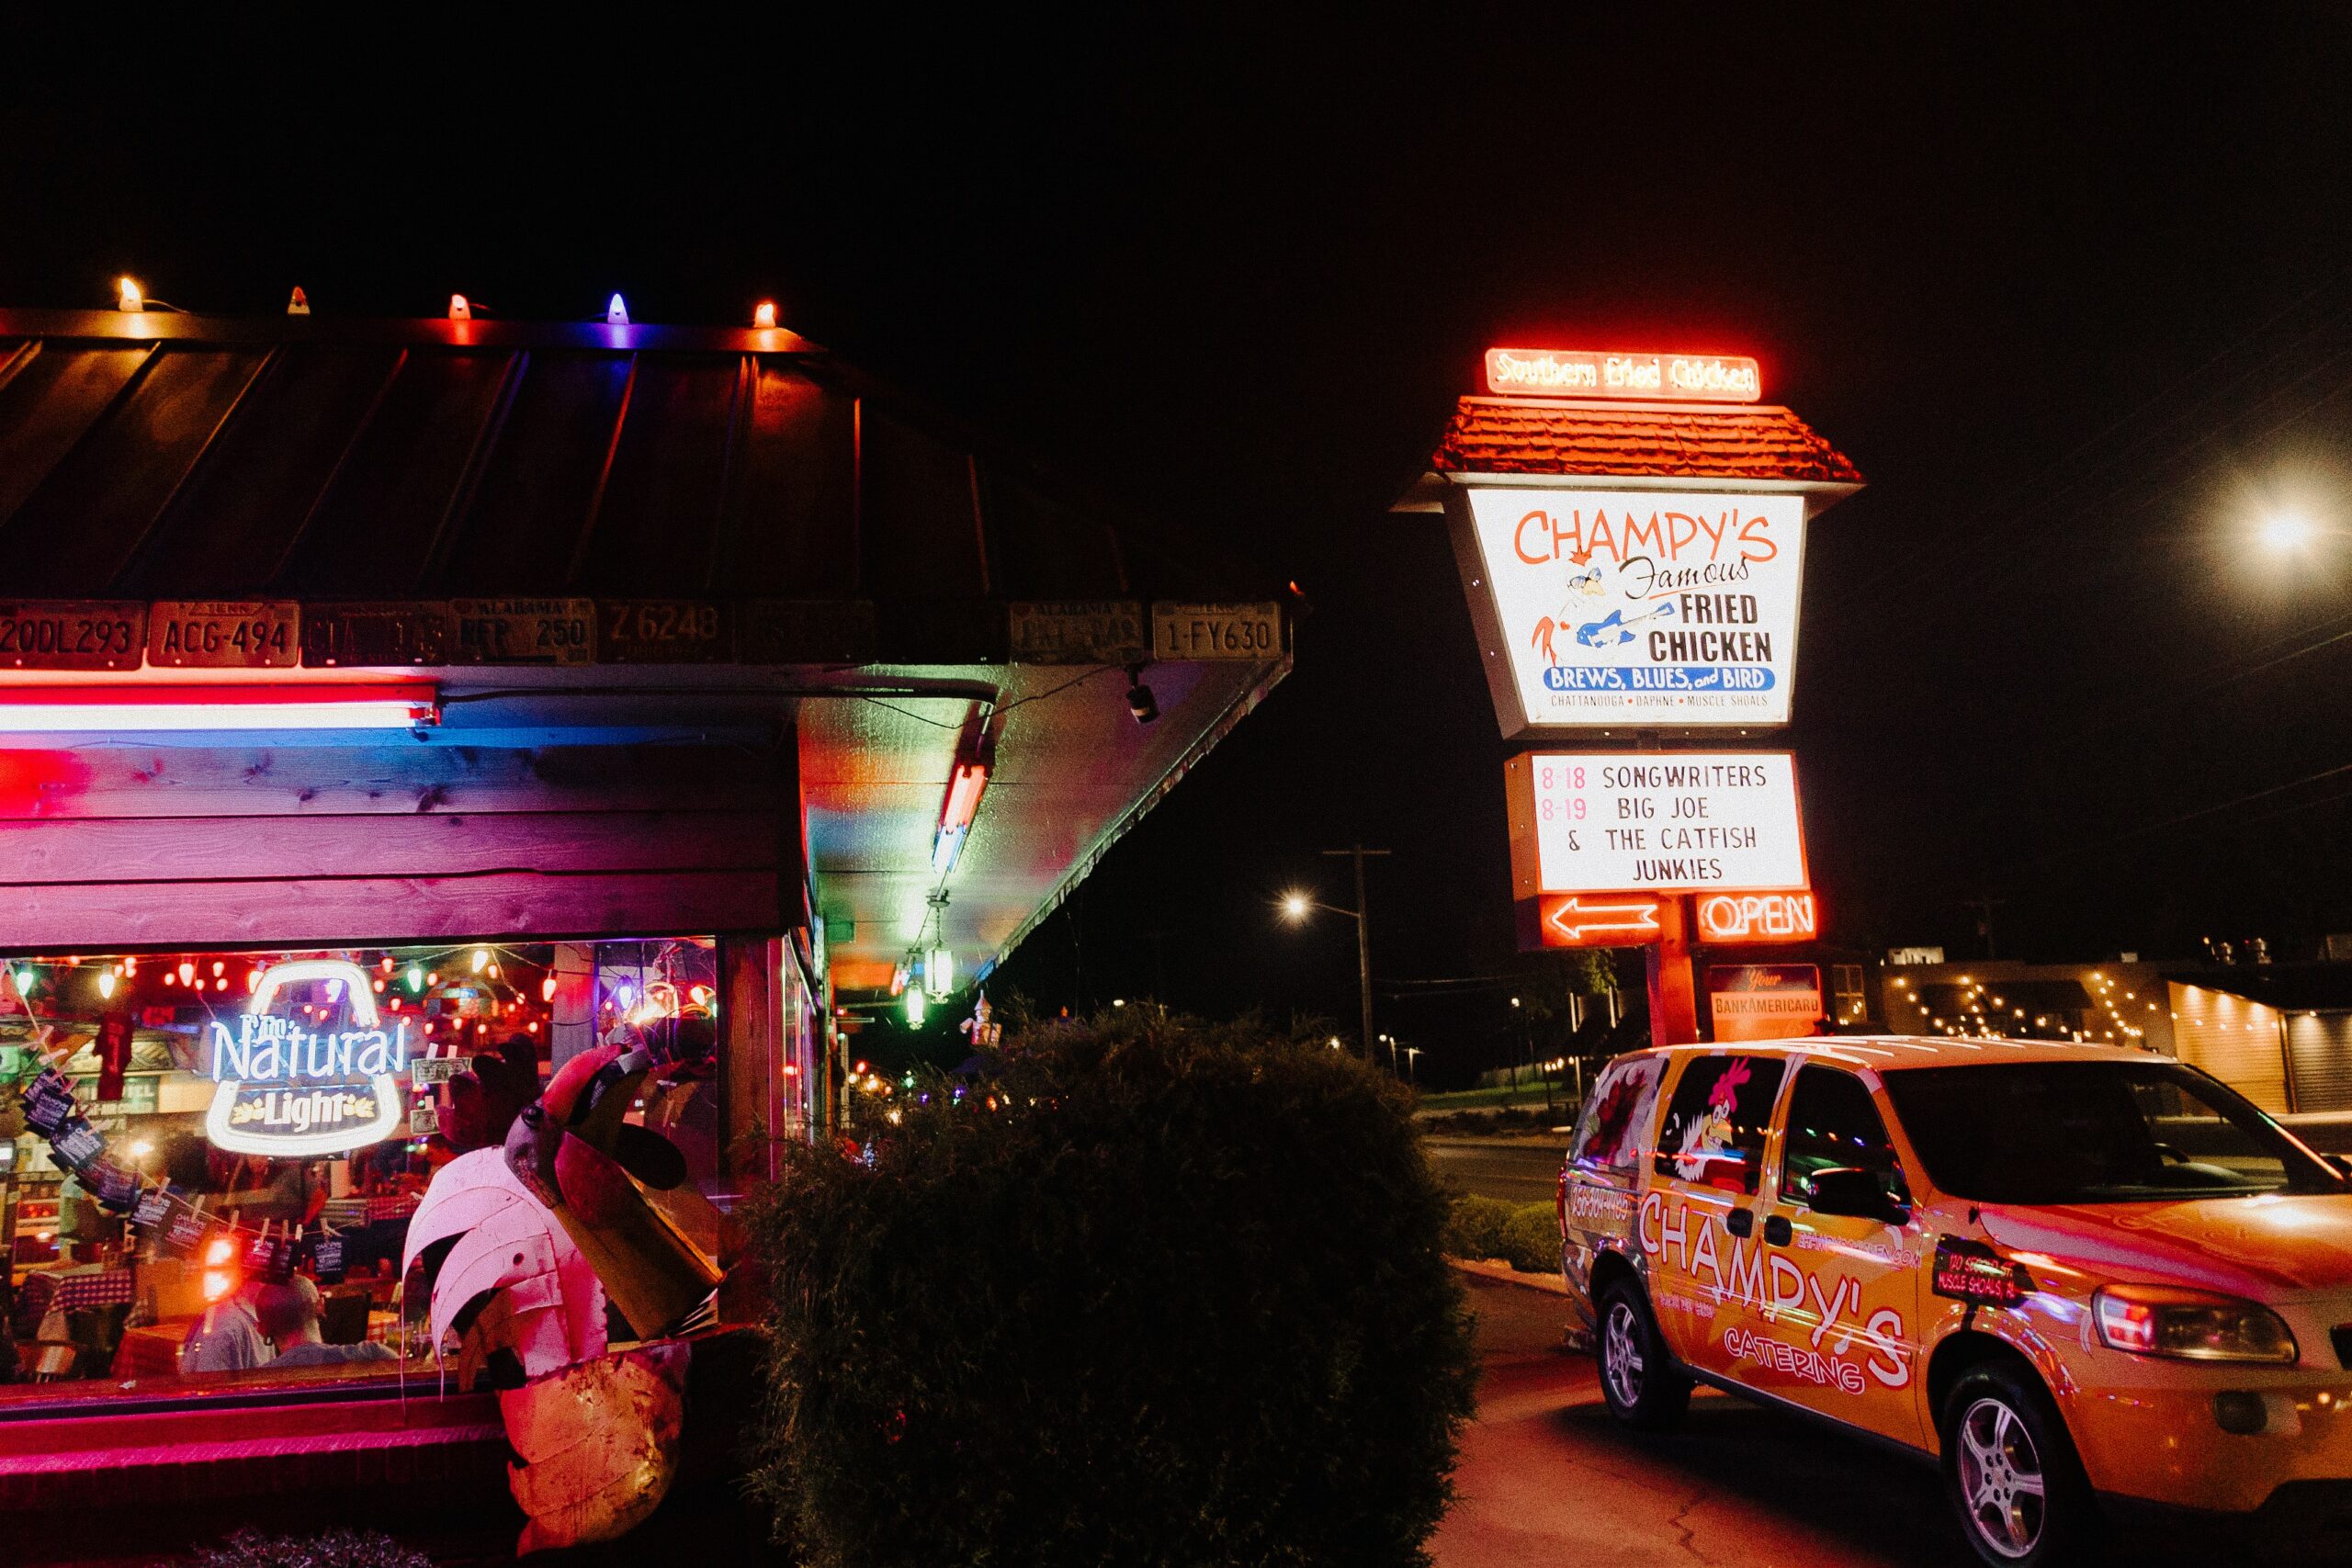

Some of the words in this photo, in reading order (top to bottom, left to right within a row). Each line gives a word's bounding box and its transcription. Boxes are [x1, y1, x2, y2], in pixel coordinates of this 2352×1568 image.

[1669, 358, 1755, 393] Chicken
[1514, 507, 1778, 565] CHAMPY'S
[1619, 556, 1749, 600] Famous
[638, 605, 718, 640] 6248
[1680, 593, 1758, 625] FRIED
[164, 620, 287, 654] ACG-494
[537, 617, 586, 648] 250
[1648, 630, 1773, 663] CHICKEN
[1550, 667, 1626, 690] BREWS,
[1632, 668, 1692, 691] BLUES,
[1694, 668, 1719, 688] and
[1723, 668, 1766, 689] BIRD
[1551, 694, 1625, 707] CHATTANOOGA
[1635, 695, 1675, 706] DAPHNE
[1687, 695, 1726, 706] MUSCLE
[1731, 695, 1769, 706] SHOALS
[1542, 766, 1586, 790] 8-18
[1602, 764, 1767, 789] SONGWRITERS
[1542, 797, 1587, 820] 8-19
[1618, 797, 1655, 819] BIG
[1671, 796, 1709, 819] JOE
[1568, 829, 1580, 851] &
[1605, 829, 1645, 851] THE
[1661, 827, 1757, 850] CATFISH
[1633, 858, 1723, 881] JUNKIES
[1705, 895, 1815, 936] OPEN
[1747, 969, 1782, 991] Your
[210, 1021, 405, 1082] Natural
[264, 1091, 346, 1134] Light
[1638, 1191, 1911, 1392] CHAMPY'S
[1939, 1271, 1966, 1291] MUSCLE
[1724, 1327, 1865, 1395] CATERING
